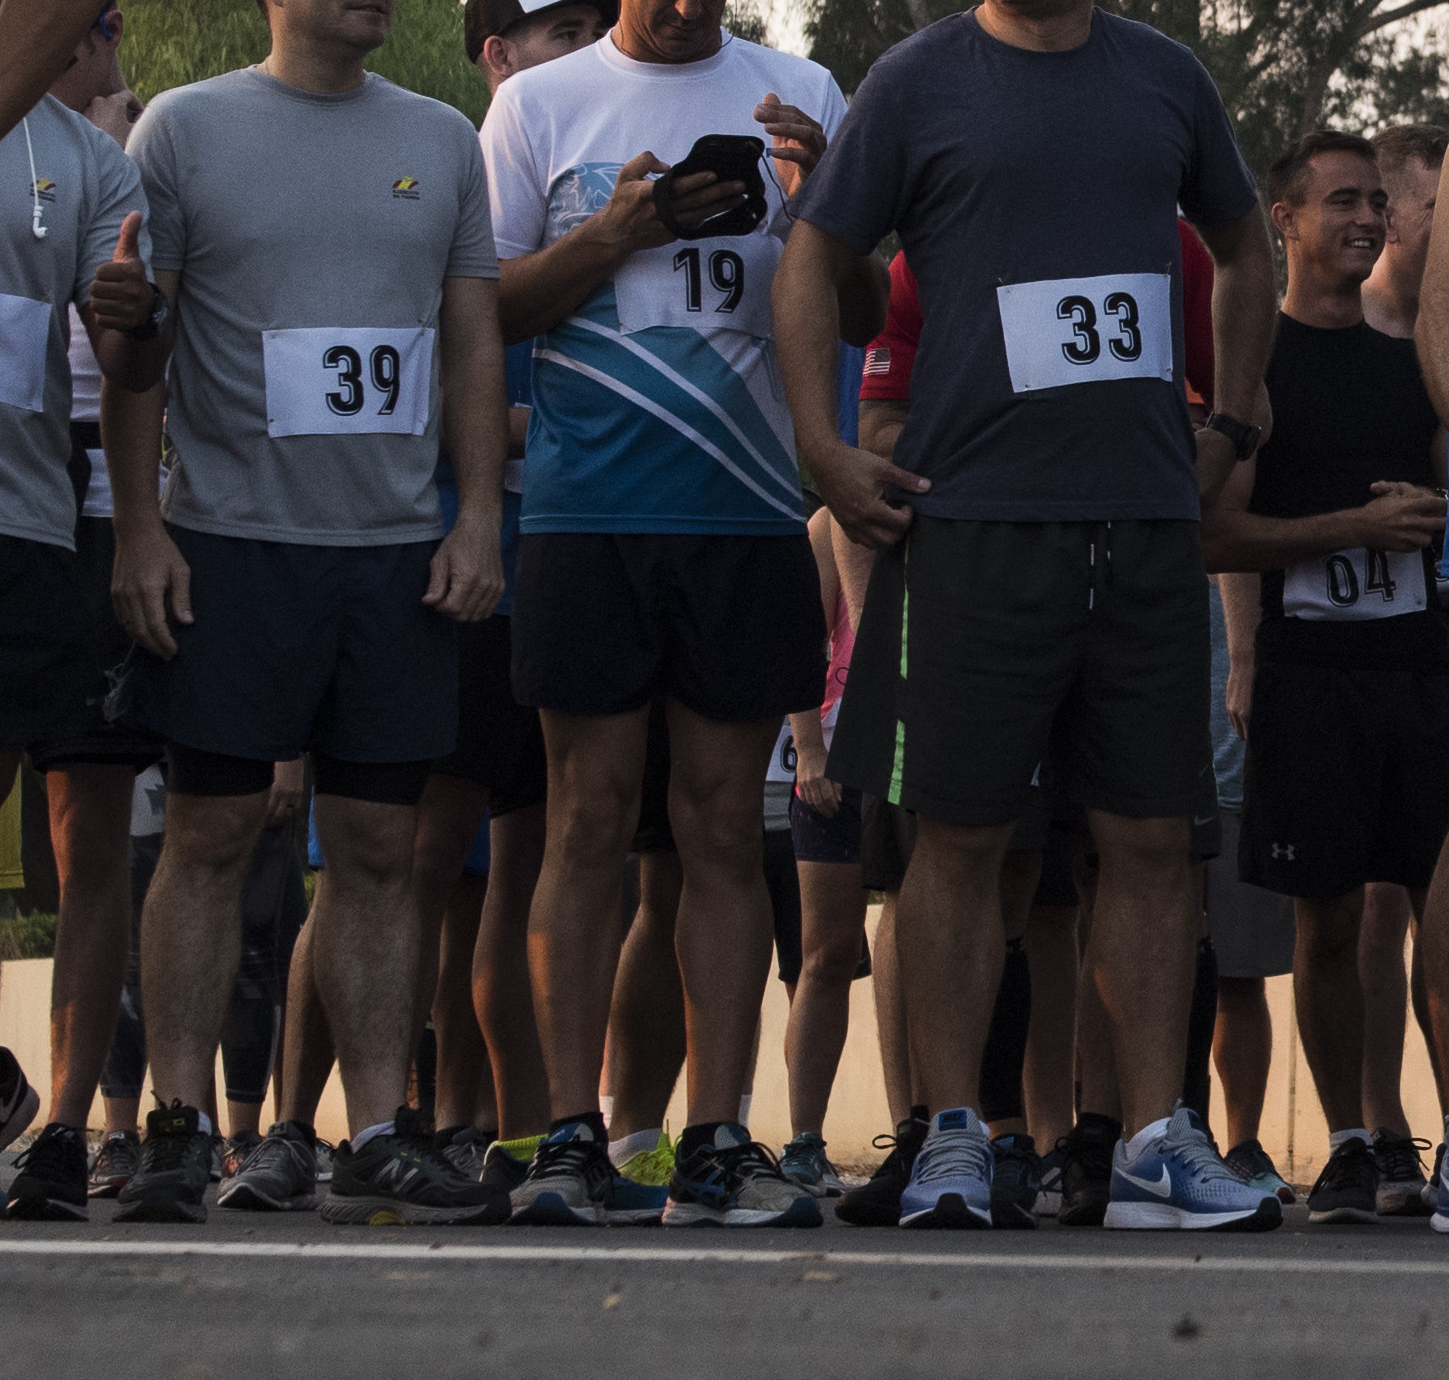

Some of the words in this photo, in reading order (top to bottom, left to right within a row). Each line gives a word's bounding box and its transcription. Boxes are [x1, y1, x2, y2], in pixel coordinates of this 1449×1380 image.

[673, 247, 745, 314] 19
[1056, 291, 1143, 366] 33
[322, 344, 400, 416] 39
[1326, 547, 1396, 608] 04
